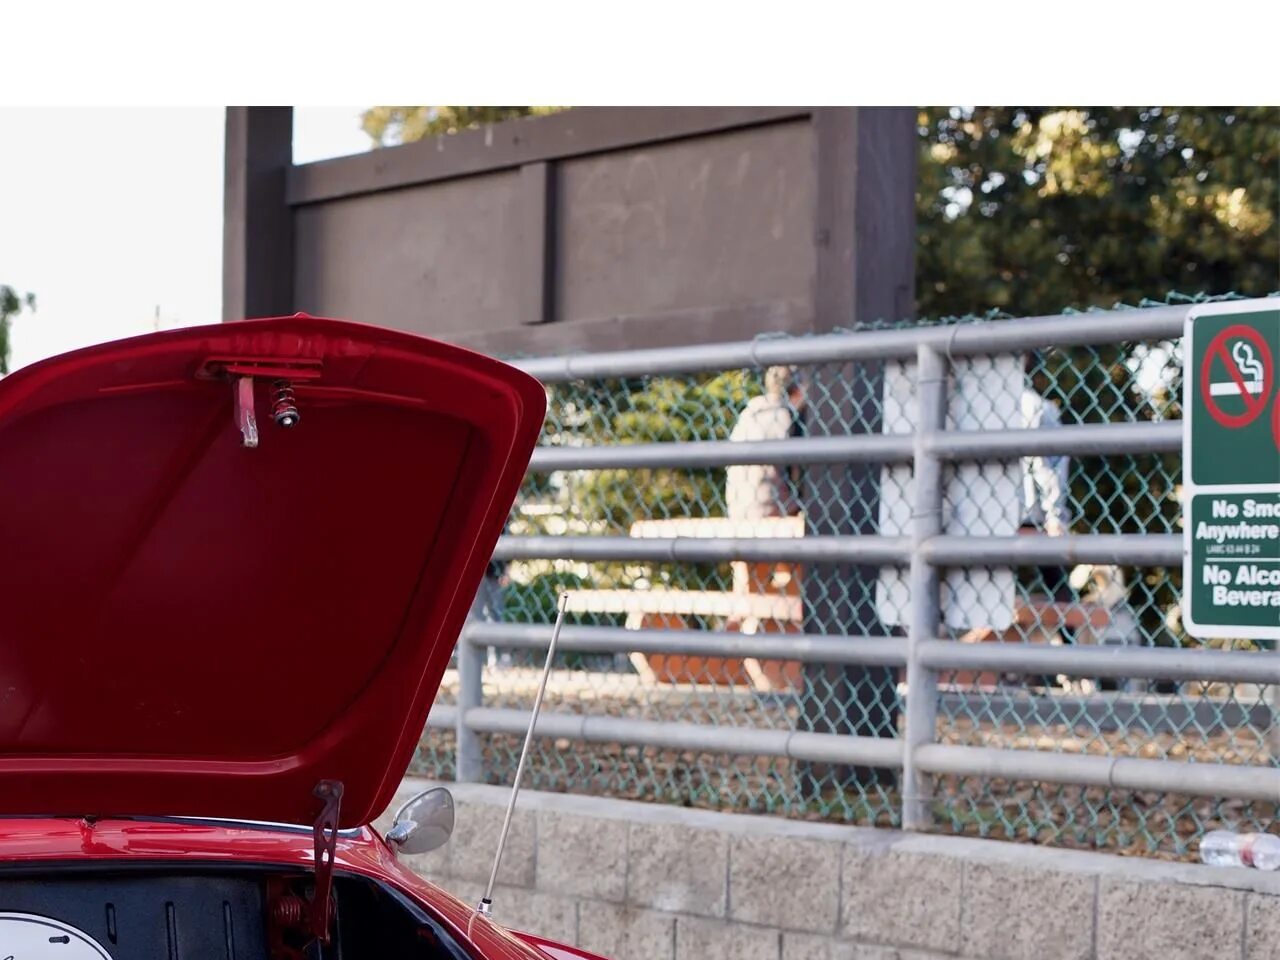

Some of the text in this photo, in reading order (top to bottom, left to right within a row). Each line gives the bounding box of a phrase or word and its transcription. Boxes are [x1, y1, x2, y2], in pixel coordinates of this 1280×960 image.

[1212, 500, 1238, 518] No
[1195, 521, 1279, 543] Anywhere
[1203, 565, 1280, 585] No Alco
[1213, 586, 1280, 606] Bevera
